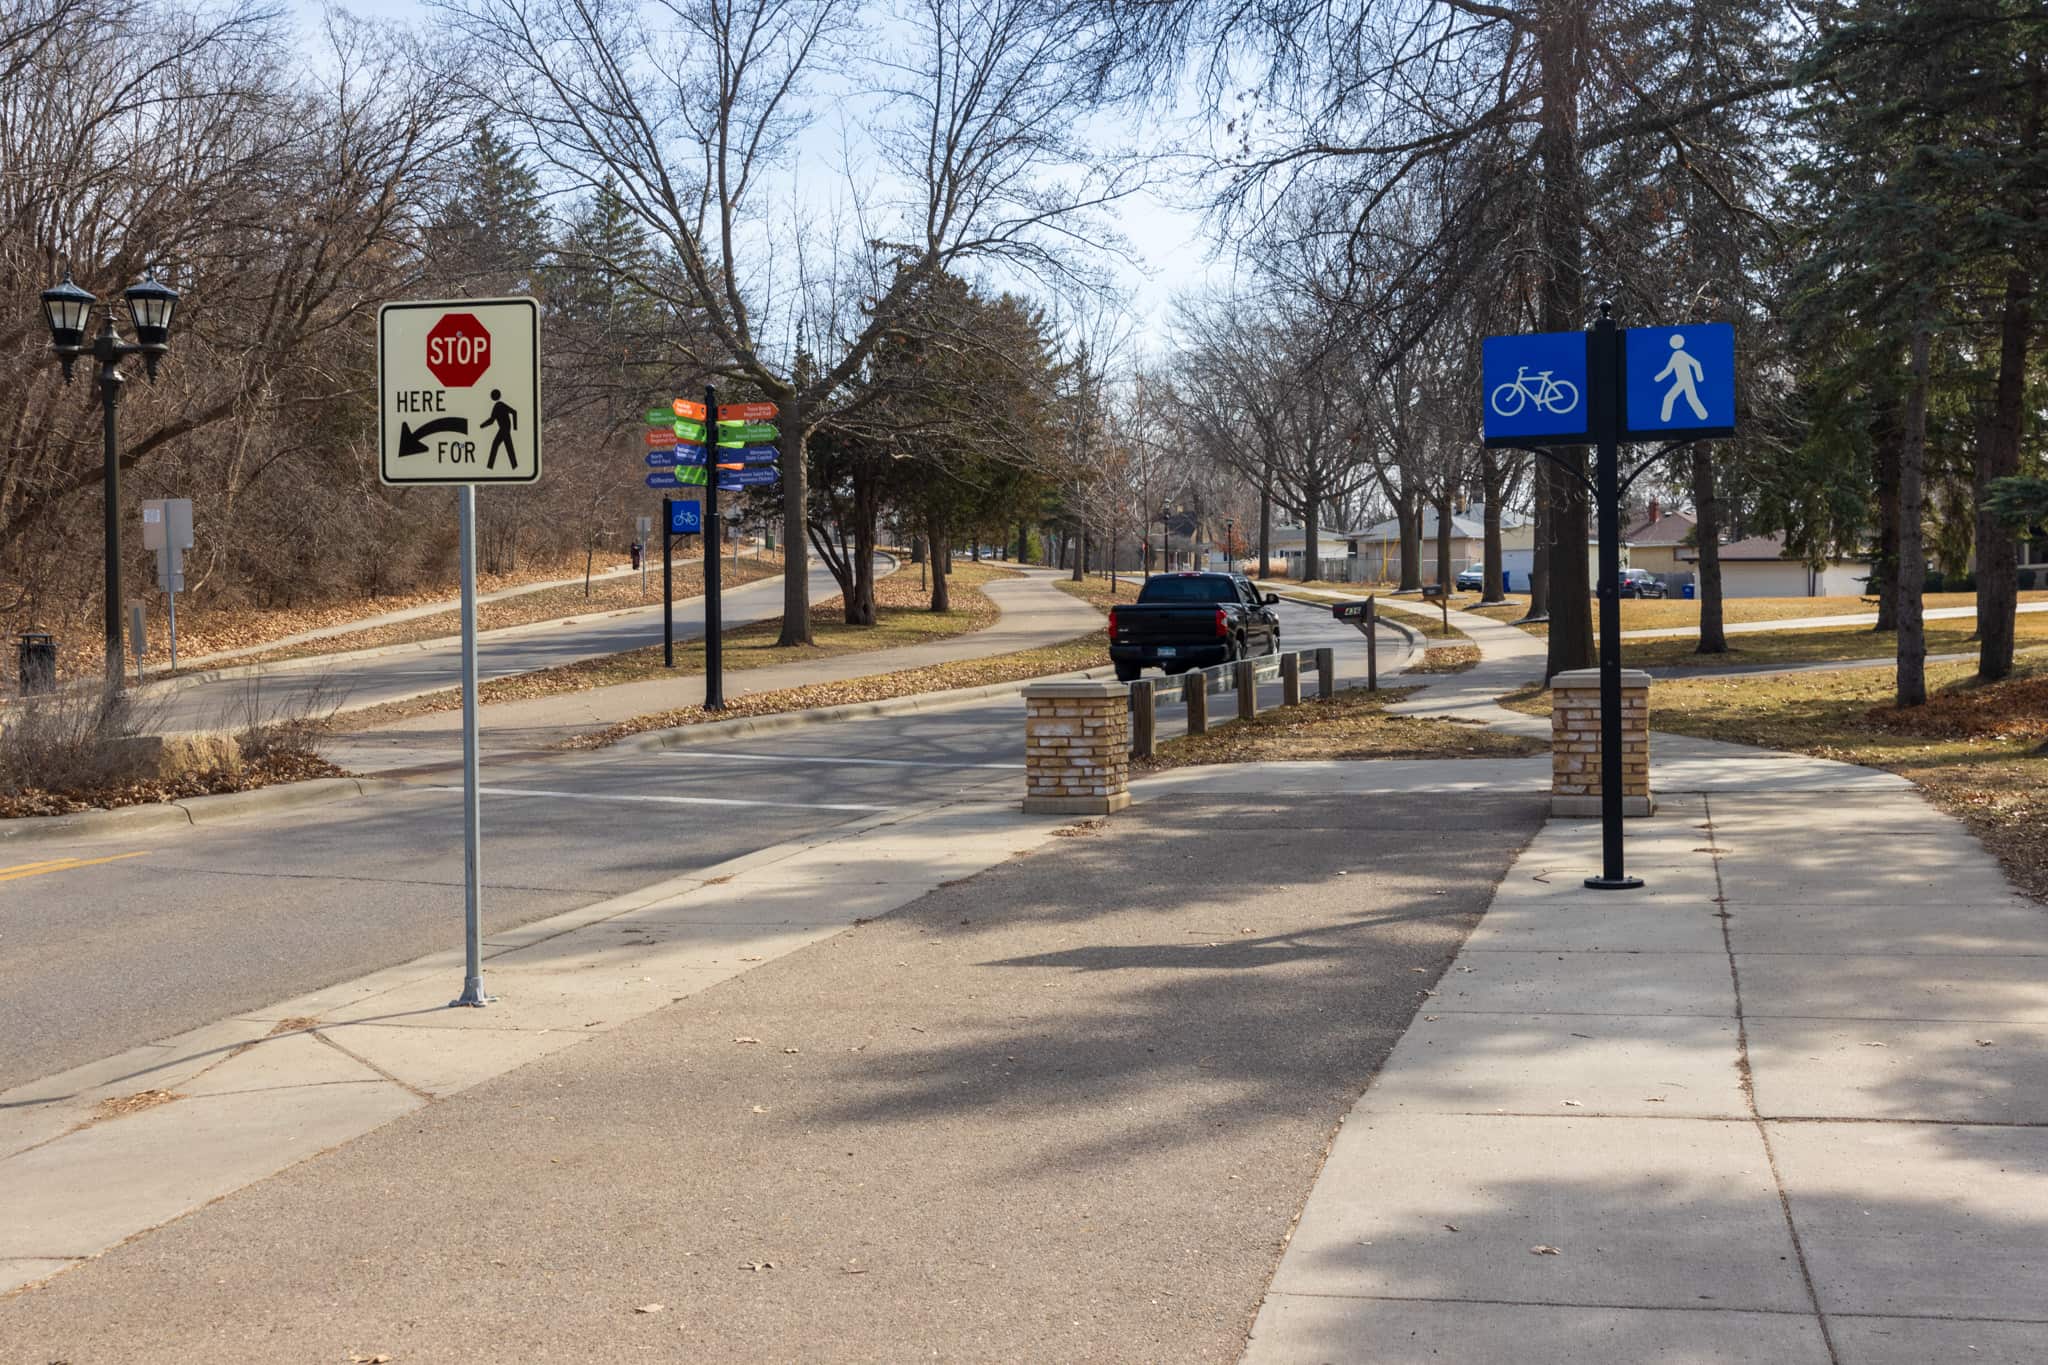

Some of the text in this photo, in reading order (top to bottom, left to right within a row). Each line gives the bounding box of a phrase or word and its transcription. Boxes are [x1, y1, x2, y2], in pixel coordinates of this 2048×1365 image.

[429, 336, 488, 365] STOP
[396, 390, 446, 413] HERE
[437, 441, 476, 464] FOR
